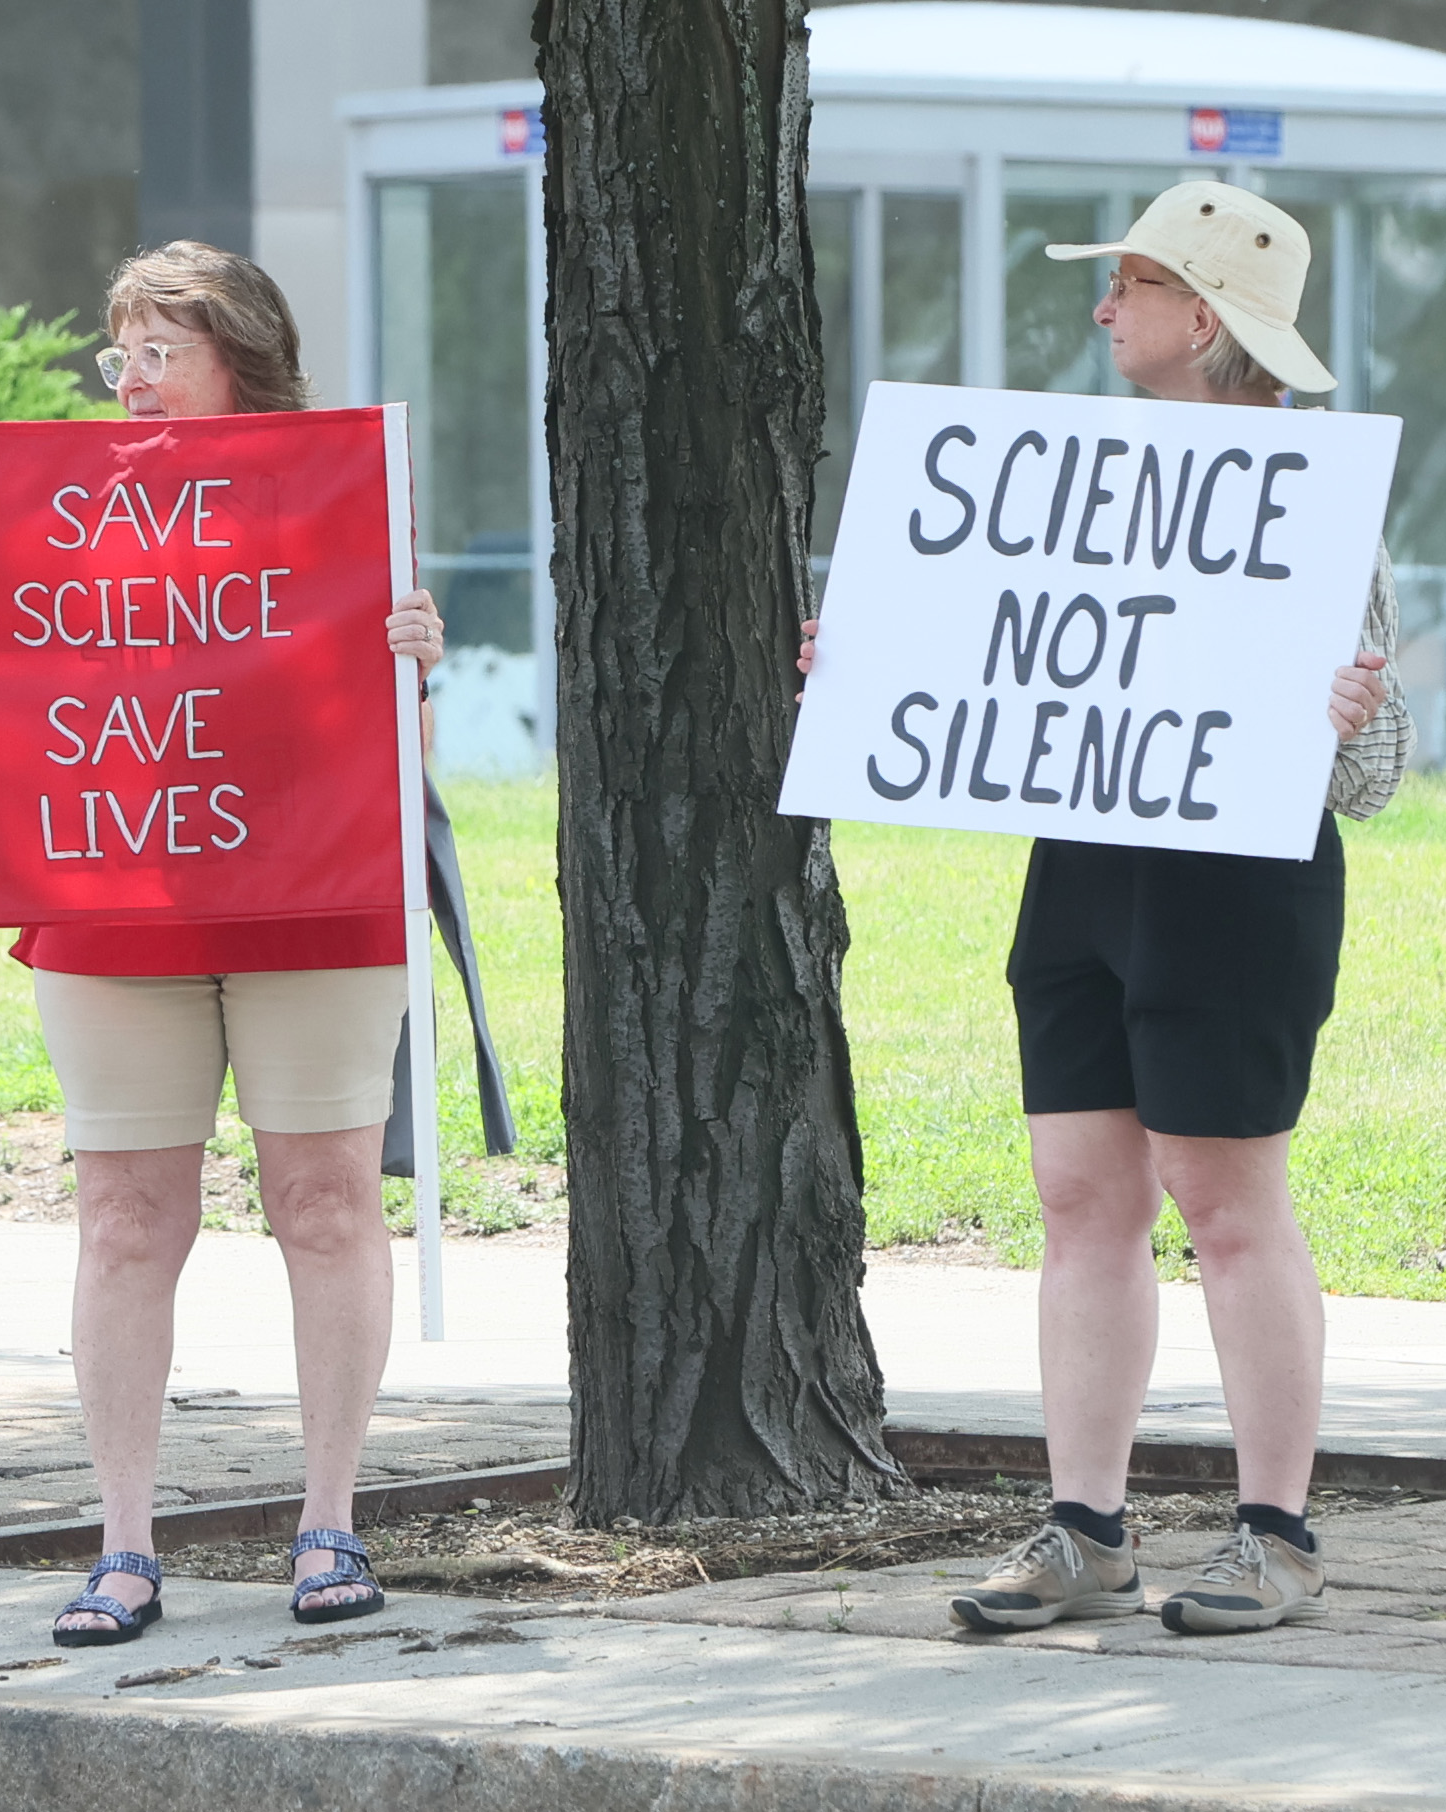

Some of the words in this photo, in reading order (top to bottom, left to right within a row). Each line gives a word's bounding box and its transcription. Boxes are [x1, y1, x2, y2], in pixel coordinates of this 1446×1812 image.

[47, 478, 232, 551] SAVE
[908, 424, 1309, 580] SCIENCE
[13, 568, 292, 647] SCIENCE
[983, 589, 1177, 690] NOT
[46, 689, 223, 765] SAVE
[867, 691, 1233, 821] SILENCE
[40, 784, 248, 861] LIVES
